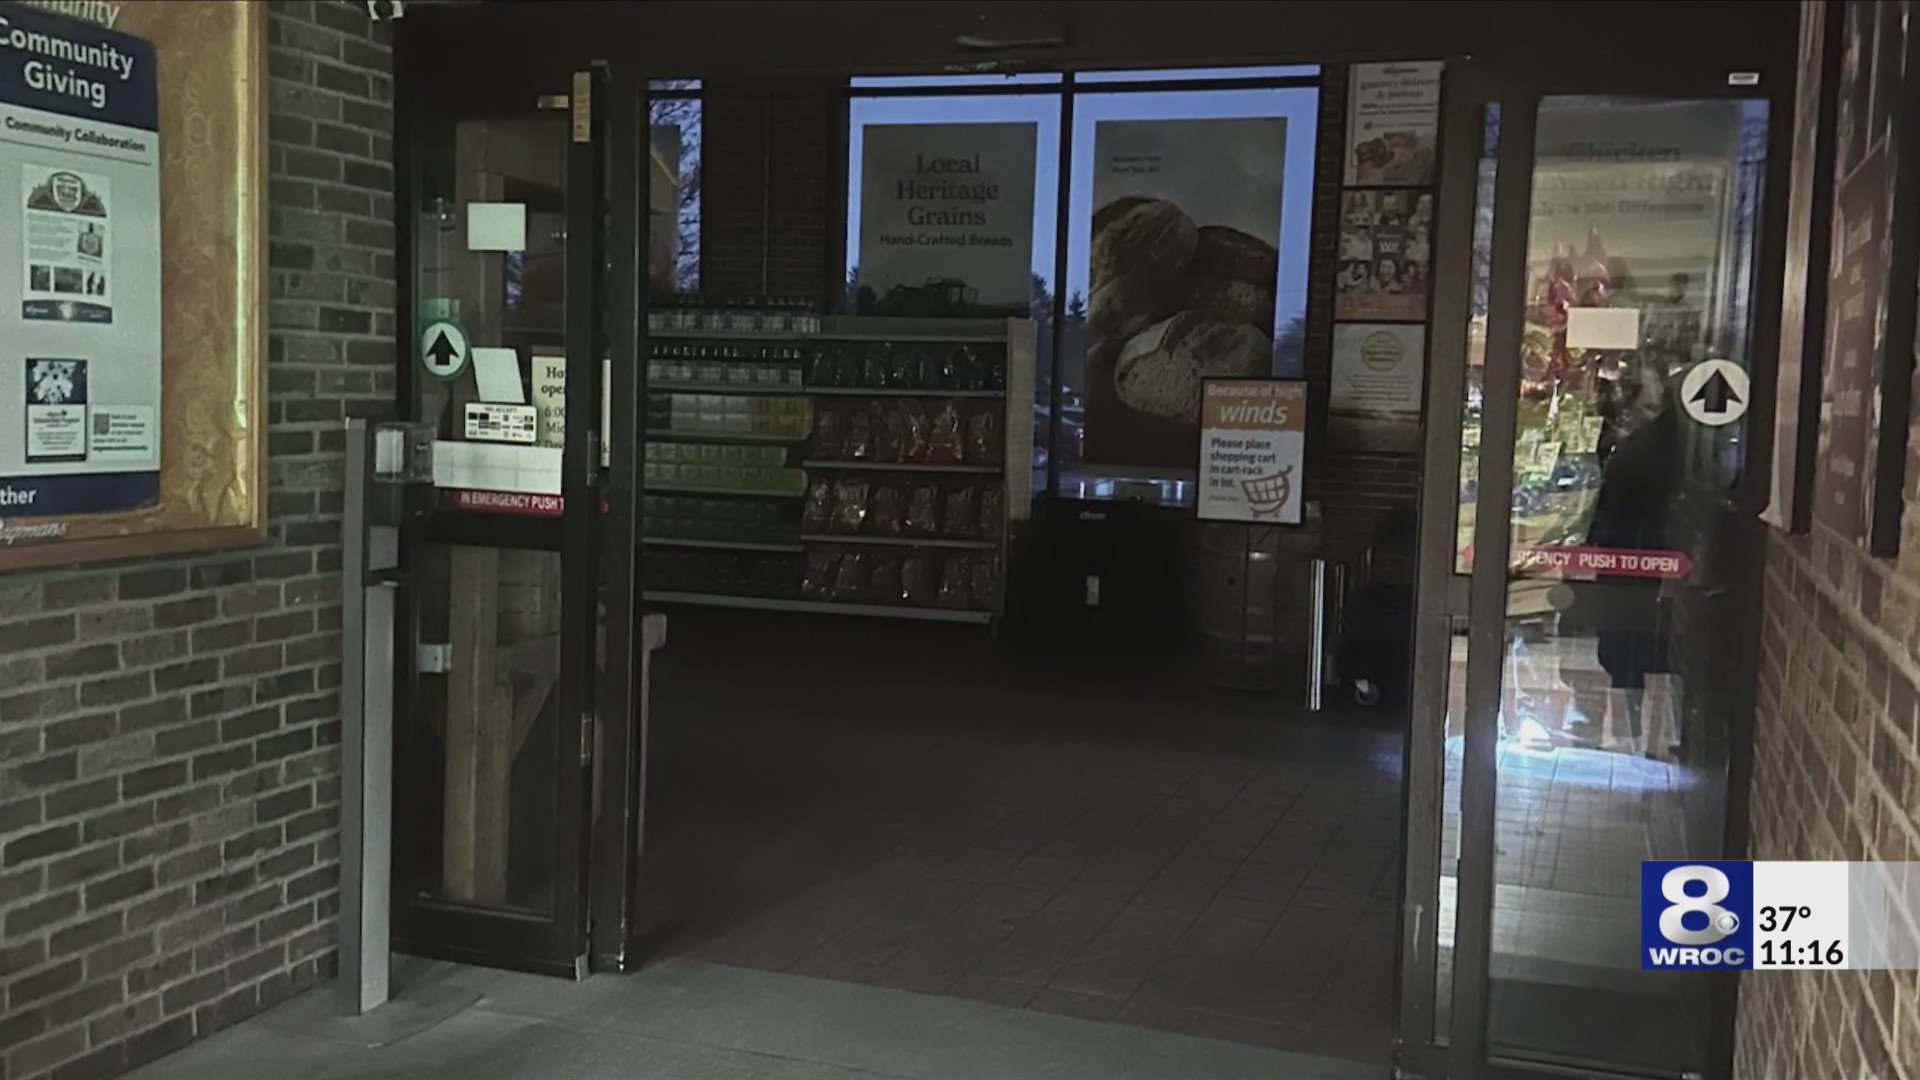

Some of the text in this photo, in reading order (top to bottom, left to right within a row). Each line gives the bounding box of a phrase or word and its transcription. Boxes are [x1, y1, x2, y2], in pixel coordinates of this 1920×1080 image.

[24, 60, 107, 108] Giving
[5, 116, 146, 152] Community Collaboration
[917, 154, 980, 174] Local
[897, 179, 999, 205] Heritage
[907, 205, 987, 226] Grains
[880, 233, 1014, 247] Hand-Crafted Breads
[546, 366, 565, 379] Ho
[541, 384, 565, 398] ope
[1208, 383, 1259, 397] Because
[1220, 399, 1288, 425] winds
[1211, 437, 1271, 451] Please place
[1210, 450, 1275, 464] shopping cart
[1210, 464, 1219, 473] in
[1209, 476, 1219, 487] in
[472, 491, 529, 508] EMERGENCY
[531, 496, 558, 511] PUSH
[0, 517, 69, 545] egmans
[1578, 552, 1617, 569] PUSH
[1619, 554, 1639, 571] TO
[1640, 556, 1680, 573] OPEN
